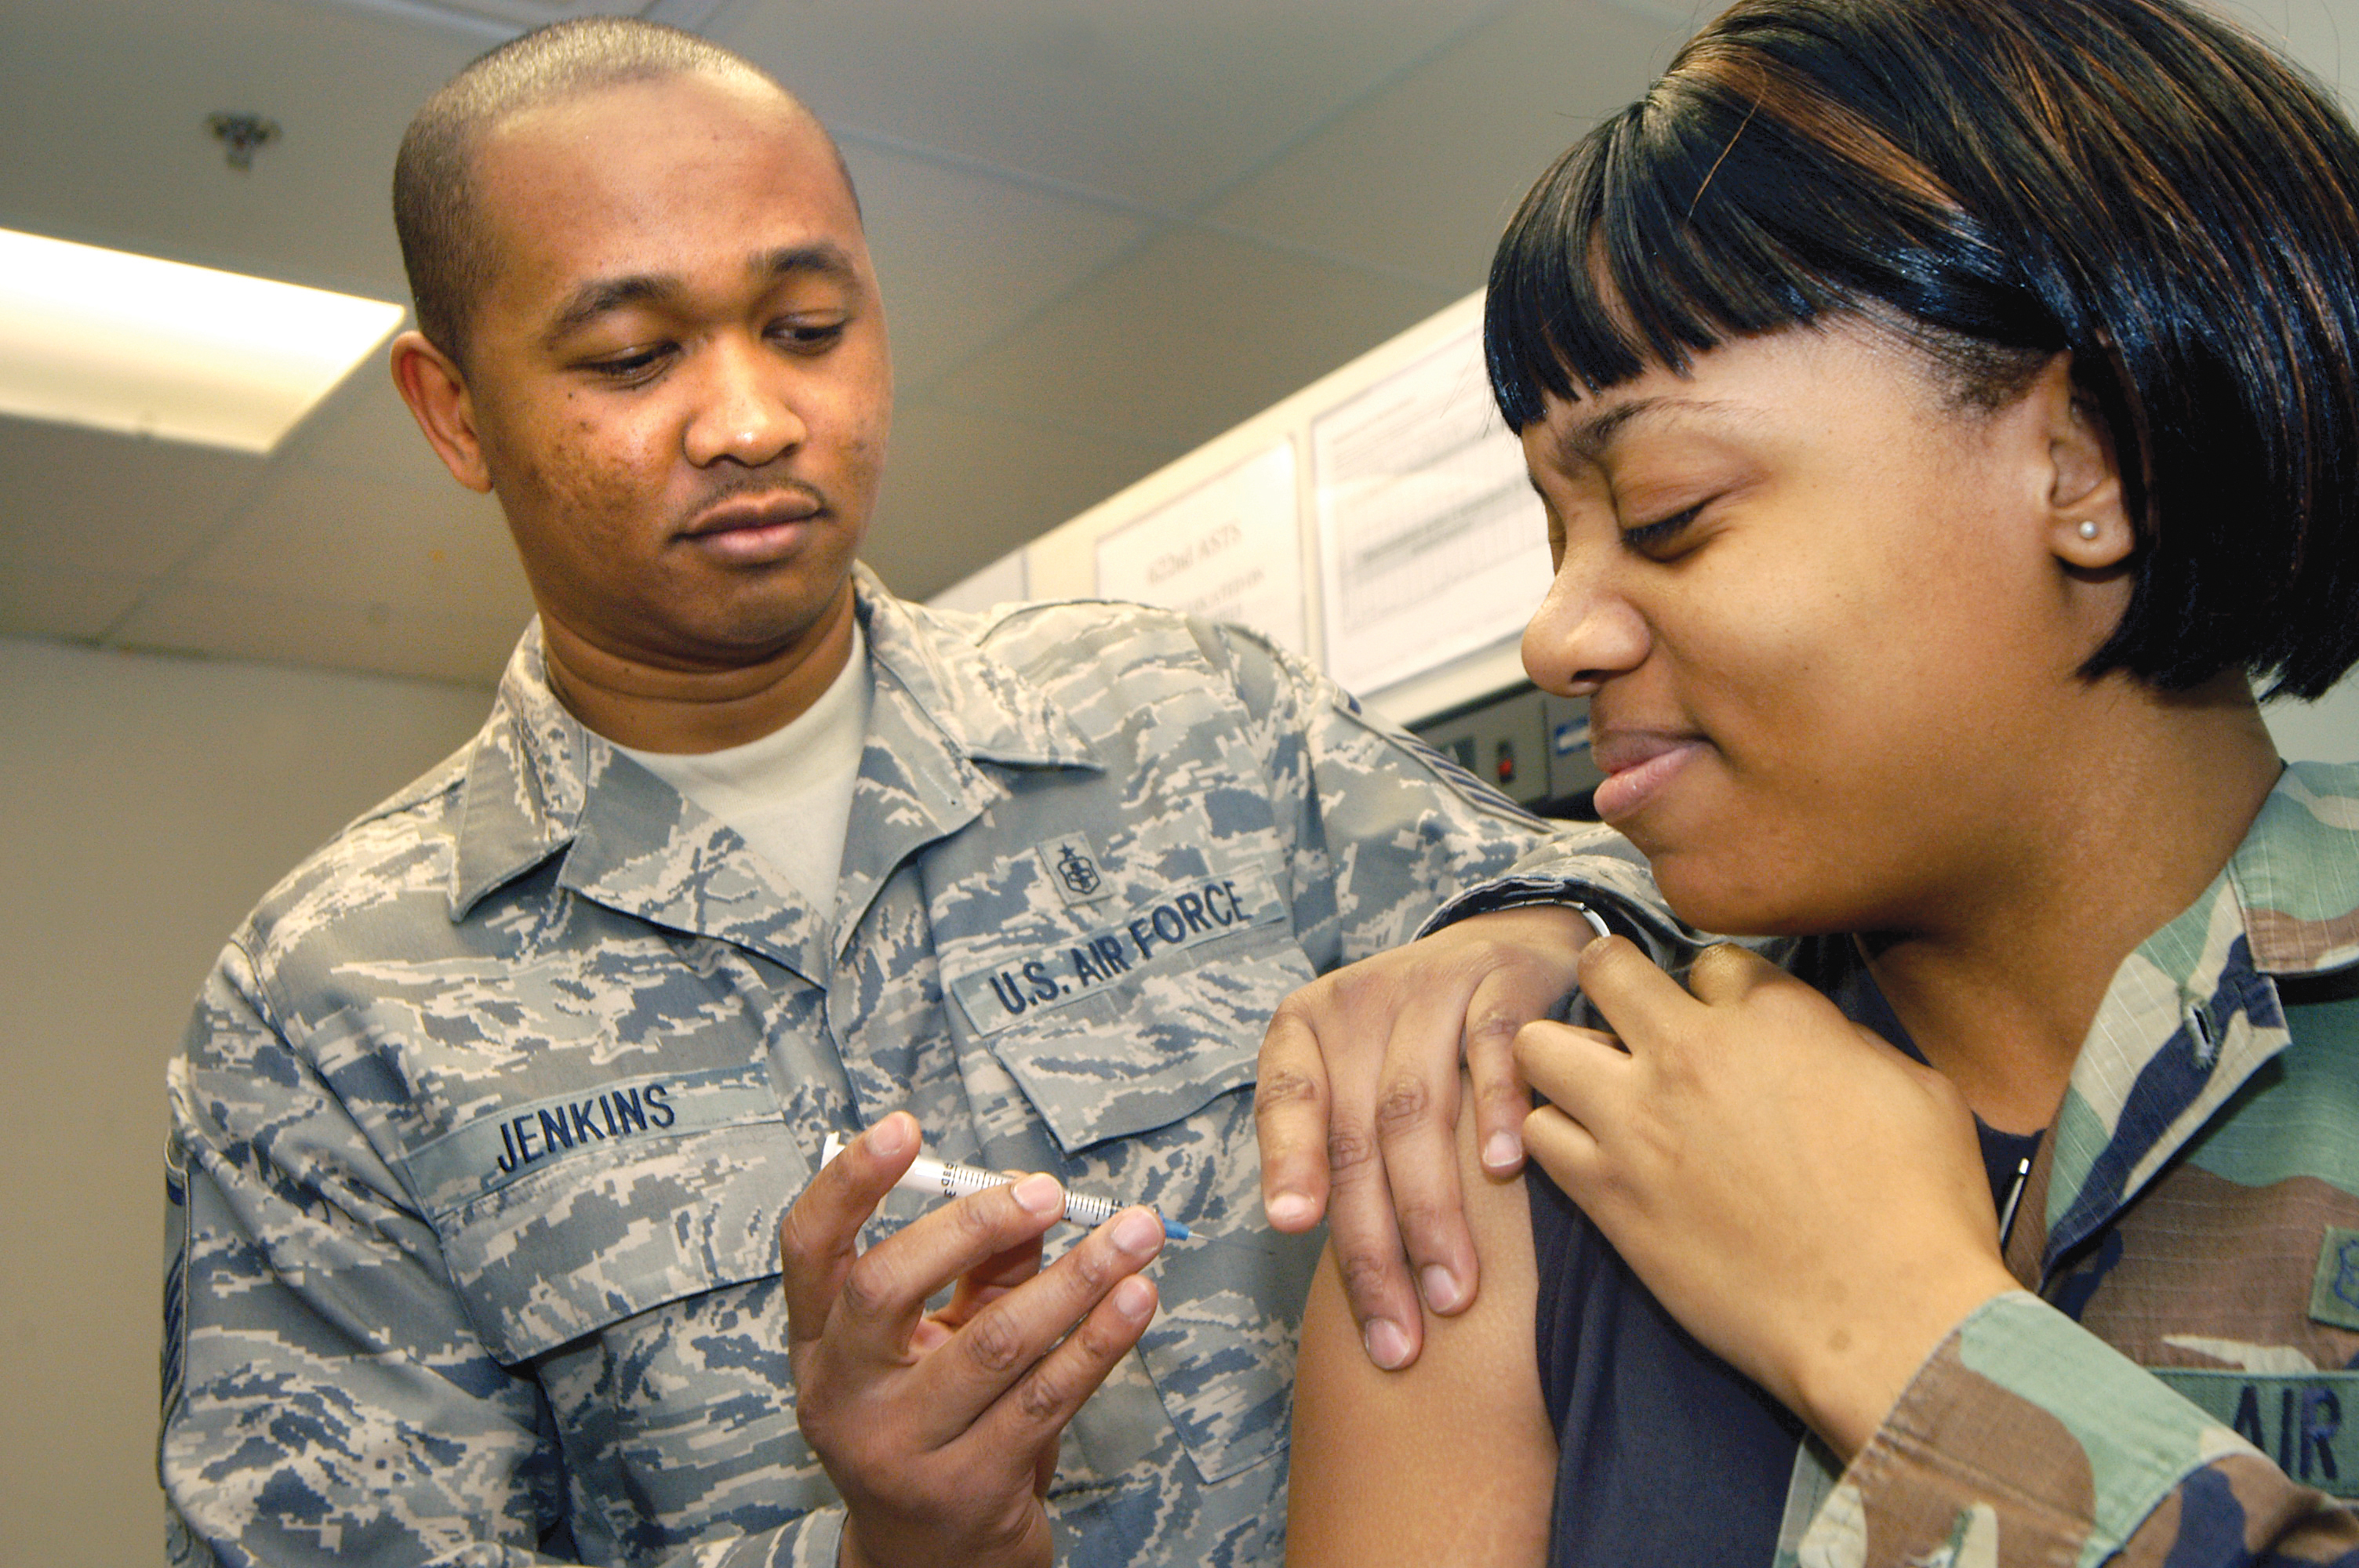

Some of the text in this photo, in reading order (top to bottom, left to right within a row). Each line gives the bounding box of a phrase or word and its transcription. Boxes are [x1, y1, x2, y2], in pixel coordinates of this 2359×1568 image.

[990, 880, 1253, 1015] U.S. AIR FORCE
[497, 1083, 675, 1173] JENKINS
[2234, 1385, 2342, 1480] AIR
